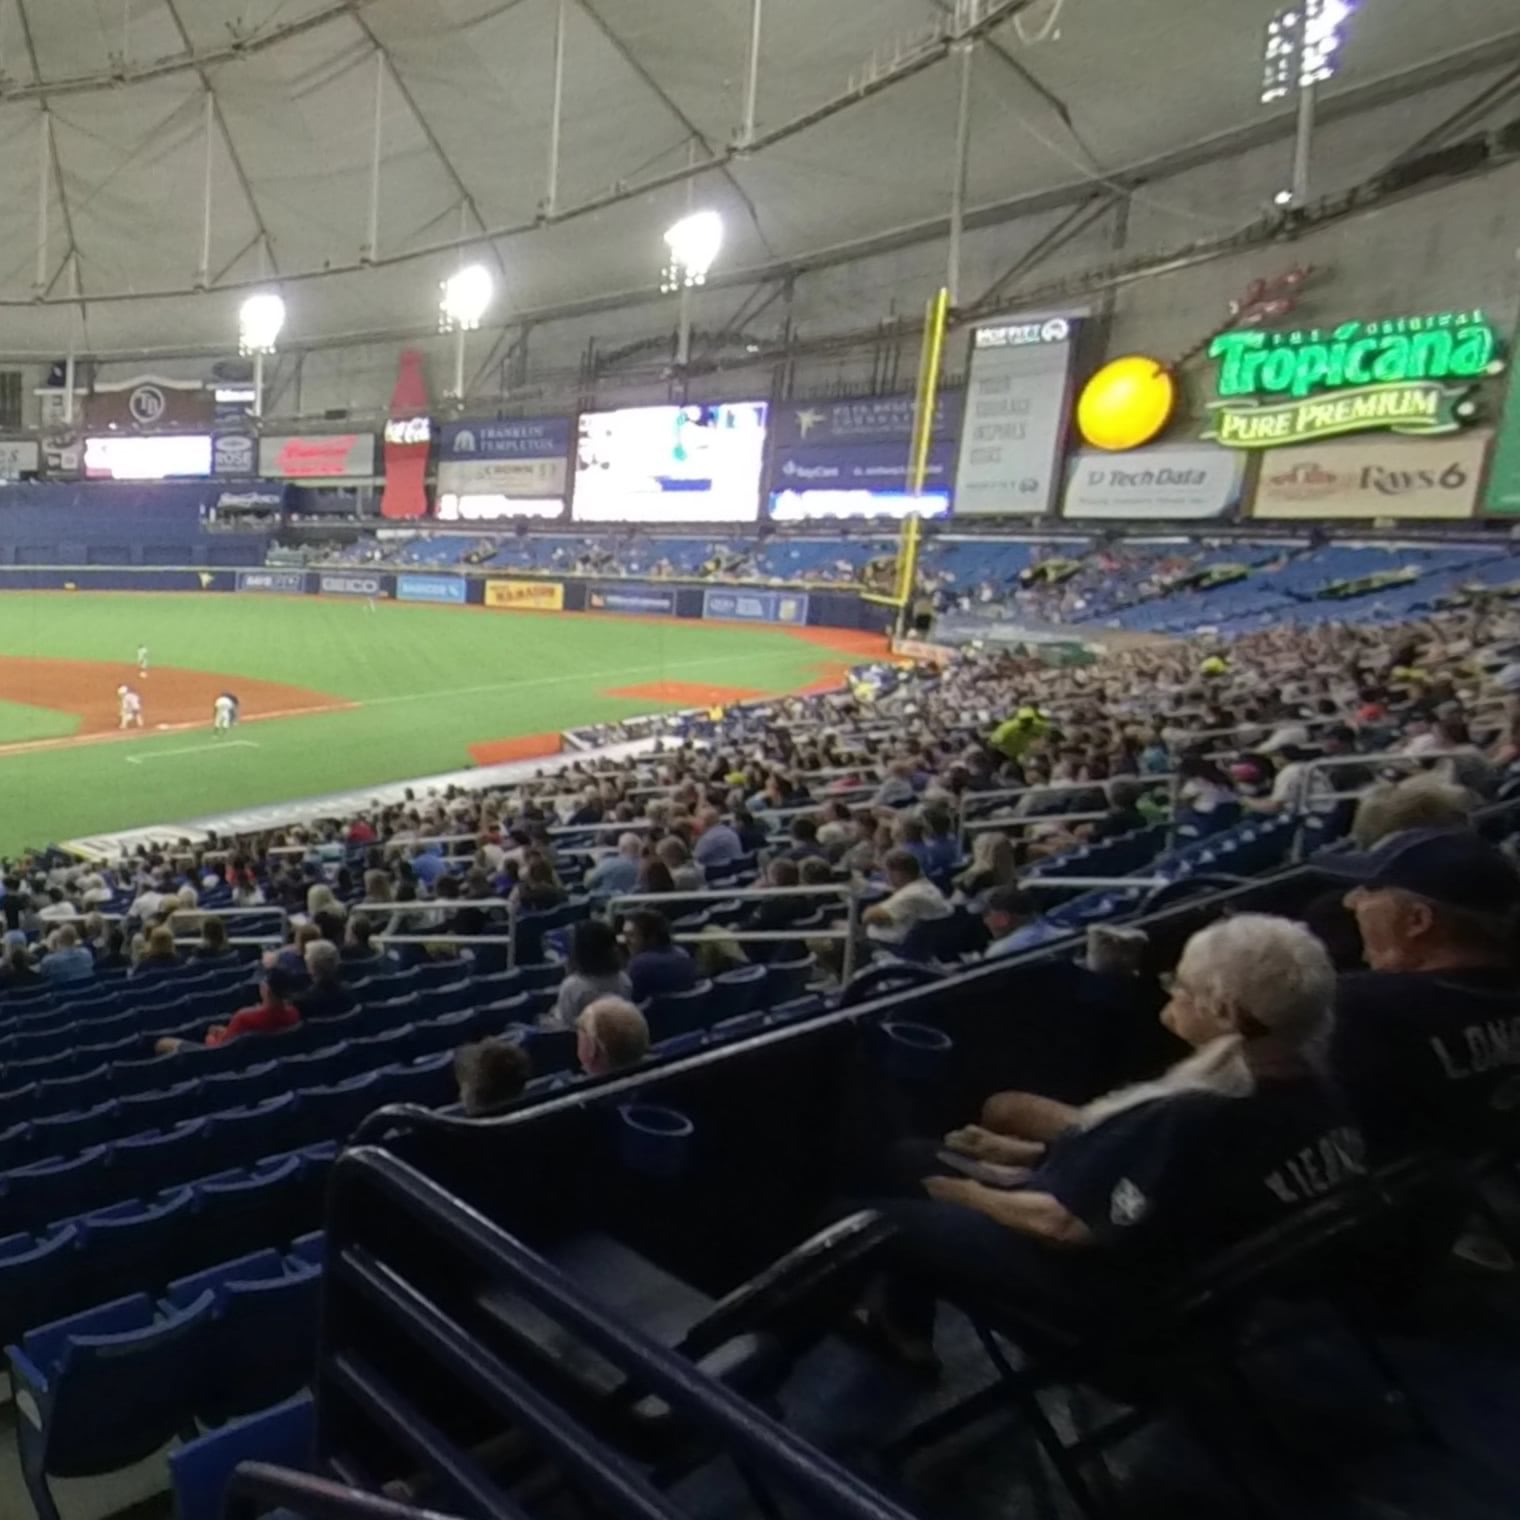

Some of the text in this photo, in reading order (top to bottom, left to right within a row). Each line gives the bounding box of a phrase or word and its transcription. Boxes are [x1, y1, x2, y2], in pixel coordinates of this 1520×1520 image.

[1209, 321, 1491, 396] Tropicana
[1221, 390, 1440, 440] PURE PREMIUM
[480, 426, 544, 439] FRANKLIN
[480, 438, 554, 452] TEMPLETON
[1438, 461, 1467, 489] 6
[321, 577, 378, 592] GEICO
